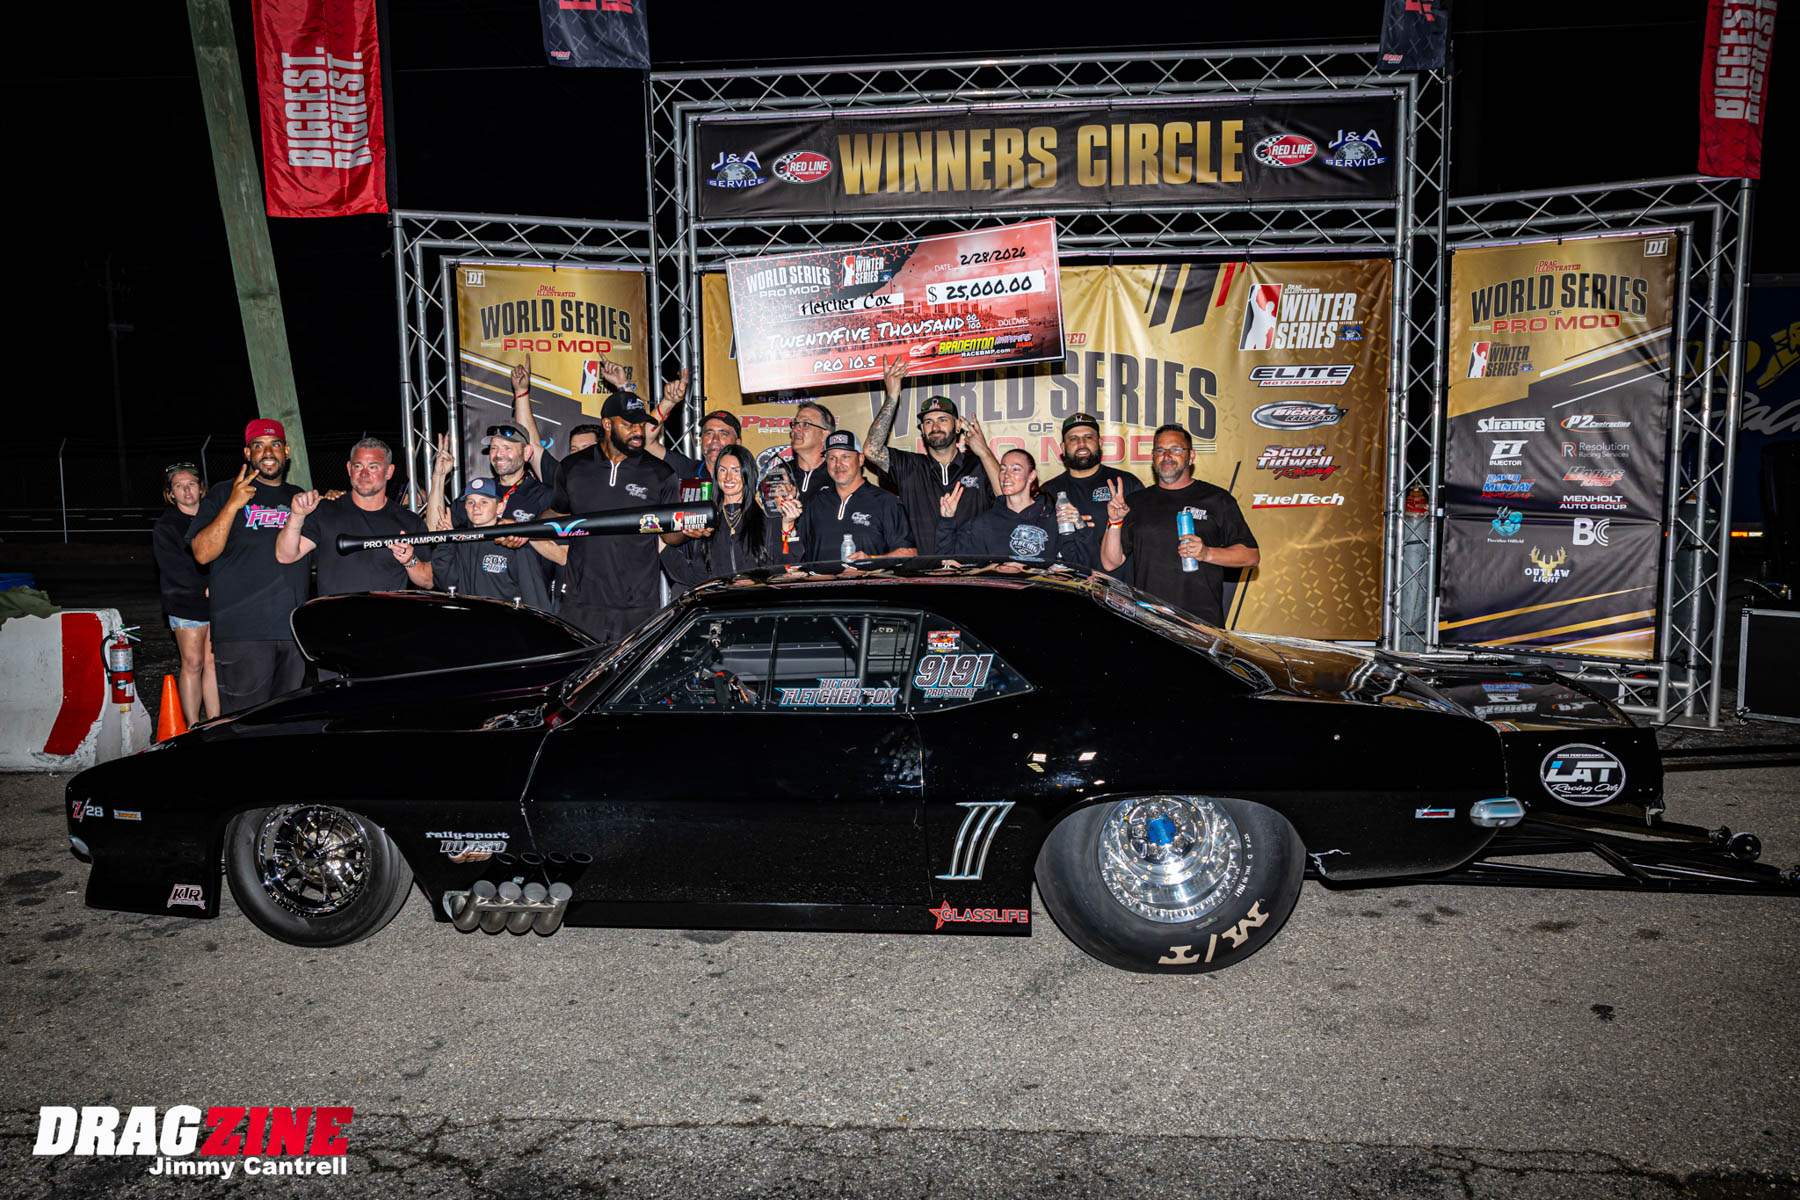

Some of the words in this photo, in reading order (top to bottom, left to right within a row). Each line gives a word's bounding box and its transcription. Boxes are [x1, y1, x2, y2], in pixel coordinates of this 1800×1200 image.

[281, 46, 333, 168] BIGGEST.
[326, 52, 373, 169] RICHEST.
[1328, 129, 1383, 149] J&A
[1271, 143, 1291, 156] RED
[1291, 142, 1313, 155] LINE
[711, 150, 762, 171] J&A
[838, 126, 1058, 195] WINNERS
[1077, 119, 1243, 187] CIRCLE
[1324, 157, 1386, 167] SERVICE
[789, 160, 808, 173] RED
[808, 159, 829, 172] LINE
[707, 176, 765, 188] SERVICE
[1646, 241, 1666, 255] DI
[960, 246, 1026, 266] 2/28/2026
[855, 257, 884, 273] WINTER
[1535, 264, 1581, 273] ILLUSTRATED
[746, 266, 788, 294] WORLD
[789, 265, 831, 286] SERIES
[855, 270, 879, 285] SERIES
[536, 290, 577, 298] ILLUSTRATED
[759, 289, 787, 298] PRO
[789, 285, 820, 296] MOD
[946, 276, 1032, 300] 25,000.00
[801, 296, 856, 316] Fletcher
[863, 294, 892, 309] Cox
[1471, 274, 1554, 325] WORLD
[1561, 272, 1648, 317] SERIES
[1280, 293, 1358, 322] WINTER
[480, 299, 555, 341] WORLD
[560, 299, 632, 344] SERIES
[877, 316, 965, 339] THOUSAND
[1492, 317, 1548, 335] PRO
[1554, 313, 1621, 331] MOD
[1274, 321, 1339, 350] SERIES
[503, 339, 552, 352] PRO
[557, 340, 612, 353] MOD
[938, 336, 995, 355] BRADENTON
[1489, 345, 1530, 362] WINTER
[813, 360, 843, 373] PRO
[849, 355, 877, 370] 10.5
[1485, 362, 1520, 377] SERIES
[1251, 367, 1351, 378] ELITE
[1049, 350, 1218, 440] SERIES
[1273, 408, 1327, 416] BICKEL
[1028, 422, 1053, 433] OF
[1476, 416, 1545, 433] Strange
[1566, 415, 1594, 429] P2
[1263, 443, 1326, 458] Scott
[1579, 441, 1630, 451] Resolution
[1255, 455, 1334, 469] Tidwell
[1579, 451, 1601, 459] Racing
[1273, 466, 1342, 481] Racing
[1252, 492, 1345, 506] FuelTech
[1563, 495, 1623, 503] MENHOLT
[684, 513, 708, 527] WINTER
[364, 540, 383, 550] PRO
[401, 535, 447, 545] CHAMPION
[1525, 567, 1571, 578] OUTLAW
[914, 653, 994, 689] 9191
[818, 678, 838, 688] BIG
[839, 678, 860, 688] GUY
[779, 687, 858, 706] FLETCHER
[860, 687, 899, 706] COX
[924, 688, 944, 698] PRO
[944, 687, 977, 698] STREET
[1545, 760, 1618, 783] LAT
[1550, 783, 1593, 794] Racing
[1594, 783, 1619, 792] Oils
[72, 797, 104, 823] Z/28
[425, 831, 510, 841] rally-sport
[940, 908, 1029, 923] GLASSLIFE
